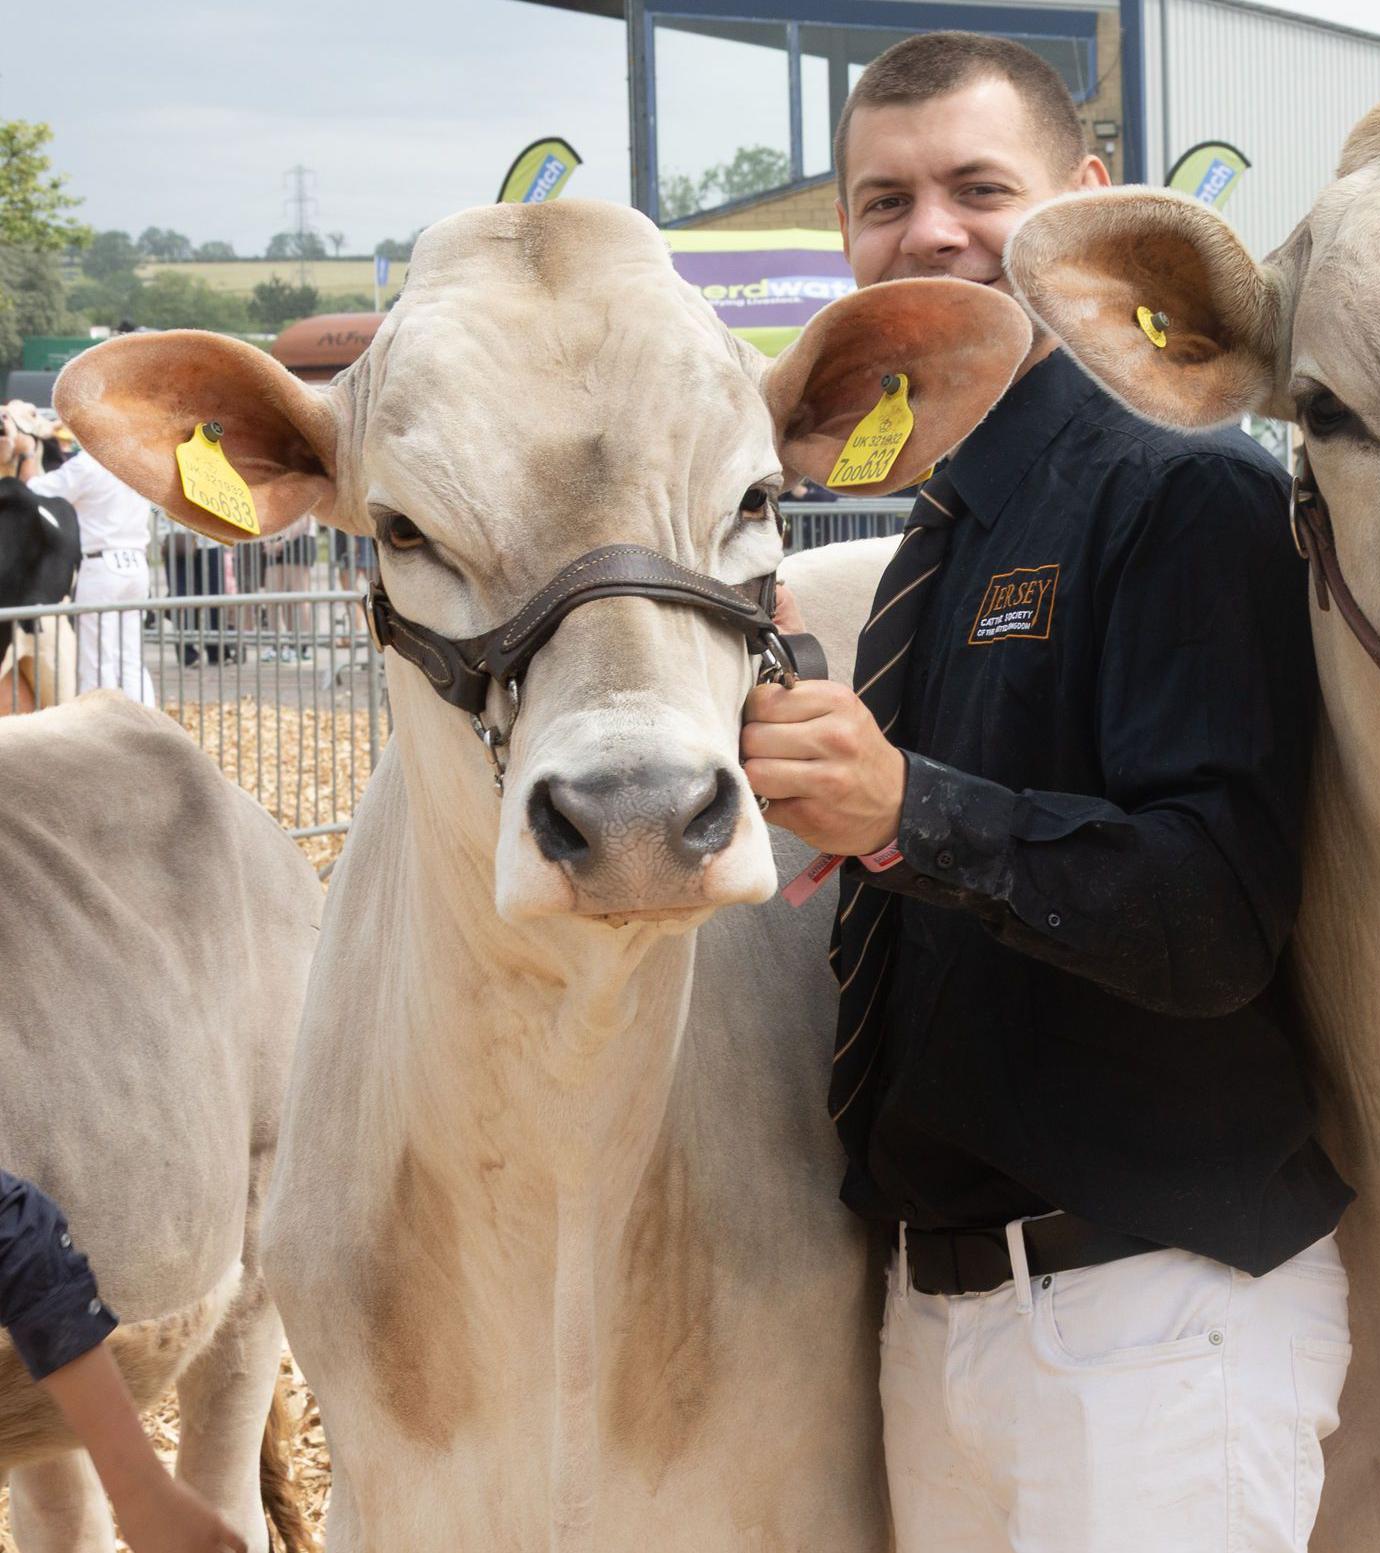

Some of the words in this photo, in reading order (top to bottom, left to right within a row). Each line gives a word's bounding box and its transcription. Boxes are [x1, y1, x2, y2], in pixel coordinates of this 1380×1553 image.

[698, 278, 857, 301] erdwat
[983, 579, 1053, 627] JERSEY
[1005, 610, 1034, 622] SOCIETY
